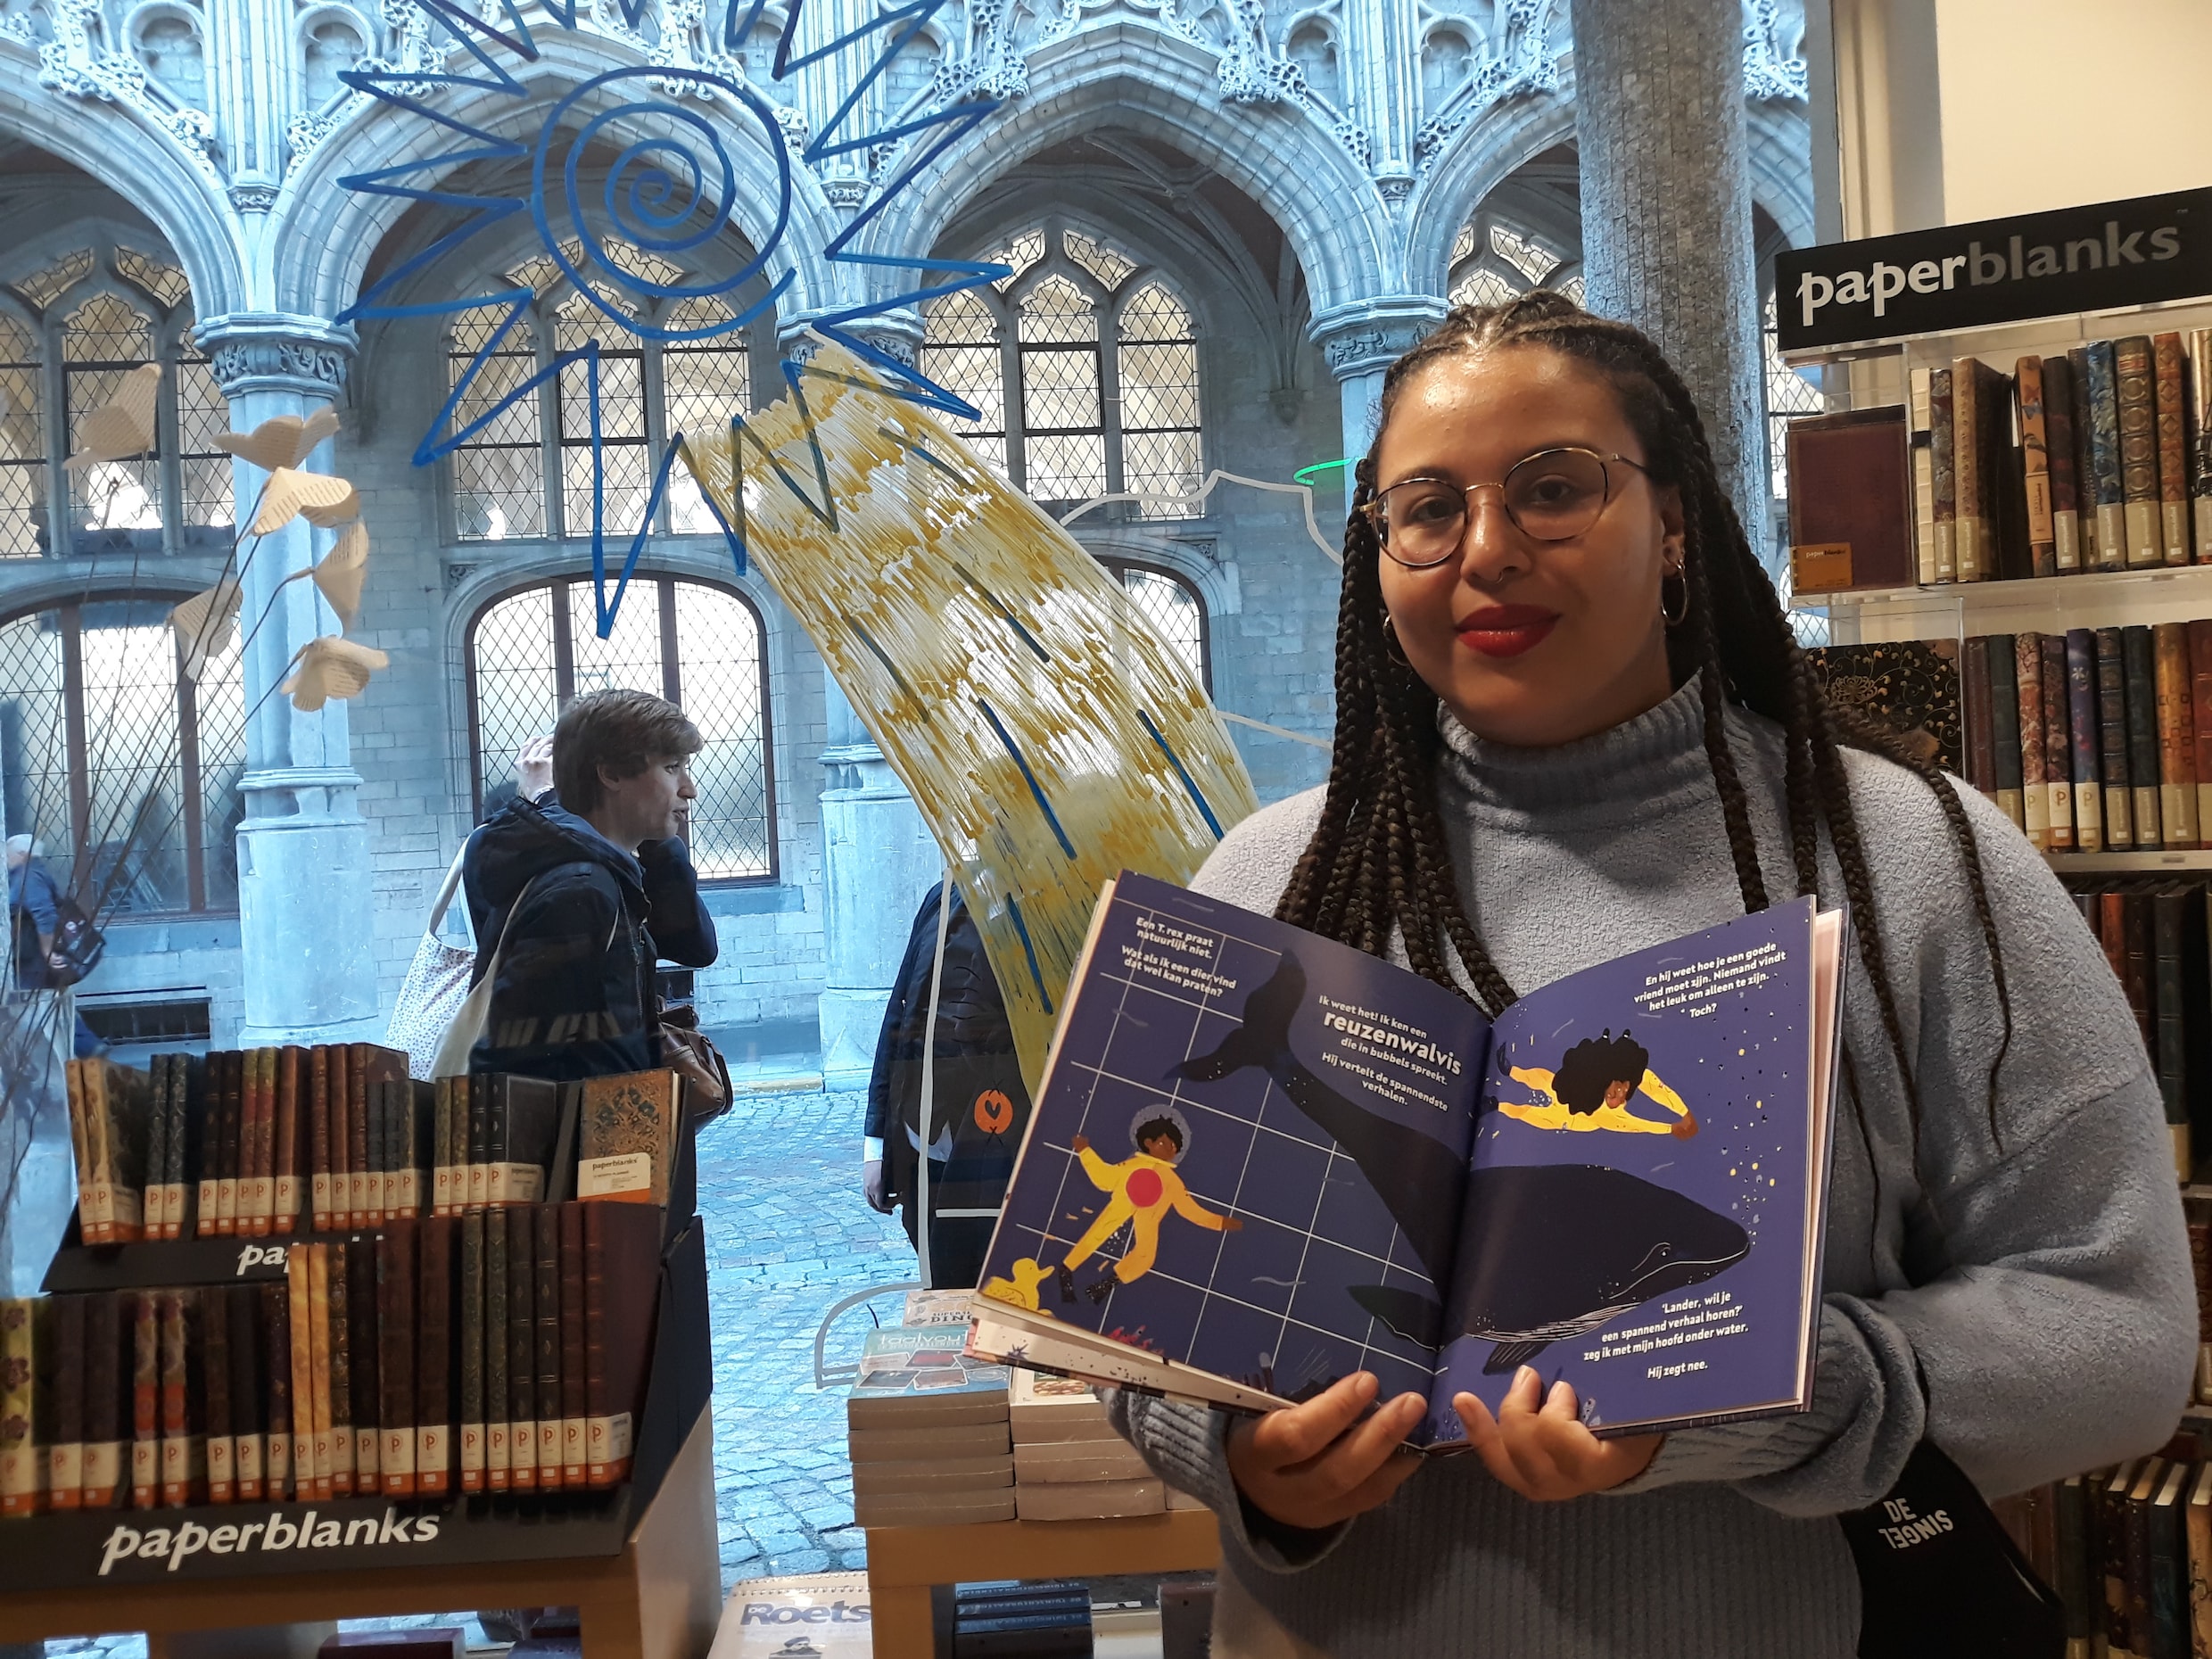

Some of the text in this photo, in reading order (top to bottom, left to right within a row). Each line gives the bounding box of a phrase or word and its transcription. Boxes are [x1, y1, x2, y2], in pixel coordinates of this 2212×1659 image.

[1795, 221, 2181, 326] paperblanks
[1135, 917, 1214, 947] Een T. rex praat
[1136, 929, 1213, 959] natuurlijk niet.
[1122, 945, 1237, 989] Wat als ik een dier vind
[1124, 959, 1224, 997] dat wel kan praten?
[1633, 951, 1787, 1003] vriend moet zijn. Niemand vindt
[1646, 942, 1777, 986] En hij weet hoe je een goede
[1649, 972, 1770, 1011] het leuk om alleen te zijn.
[1689, 1003, 1717, 1019] Toch?
[1318, 995, 1427, 1039] Ik weet het! Ik ken een
[1324, 1011, 1462, 1076] reuzenwalvis
[1341, 1037, 1448, 1085] die in bubbels spreekt.
[1322, 1052, 1449, 1112] Hij vertelt de spannendste
[1362, 1080, 1408, 1106] verhalen.
[1704, 1292, 1720, 1306] wil
[1721, 1291, 1731, 1305] je
[1583, 1323, 1749, 1362] zeg ik met mijn hoofd onder water.
[1601, 1332, 1619, 1342] een
[1621, 1319, 1667, 1341] spannend
[1668, 1311, 1704, 1329] verhaal
[1647, 1360, 1708, 1379] Hij zegt nee.
[1883, 1498, 1918, 1523] DE
[97, 1506, 441, 1576] paperblanks
[739, 1600, 871, 1625] Roets
